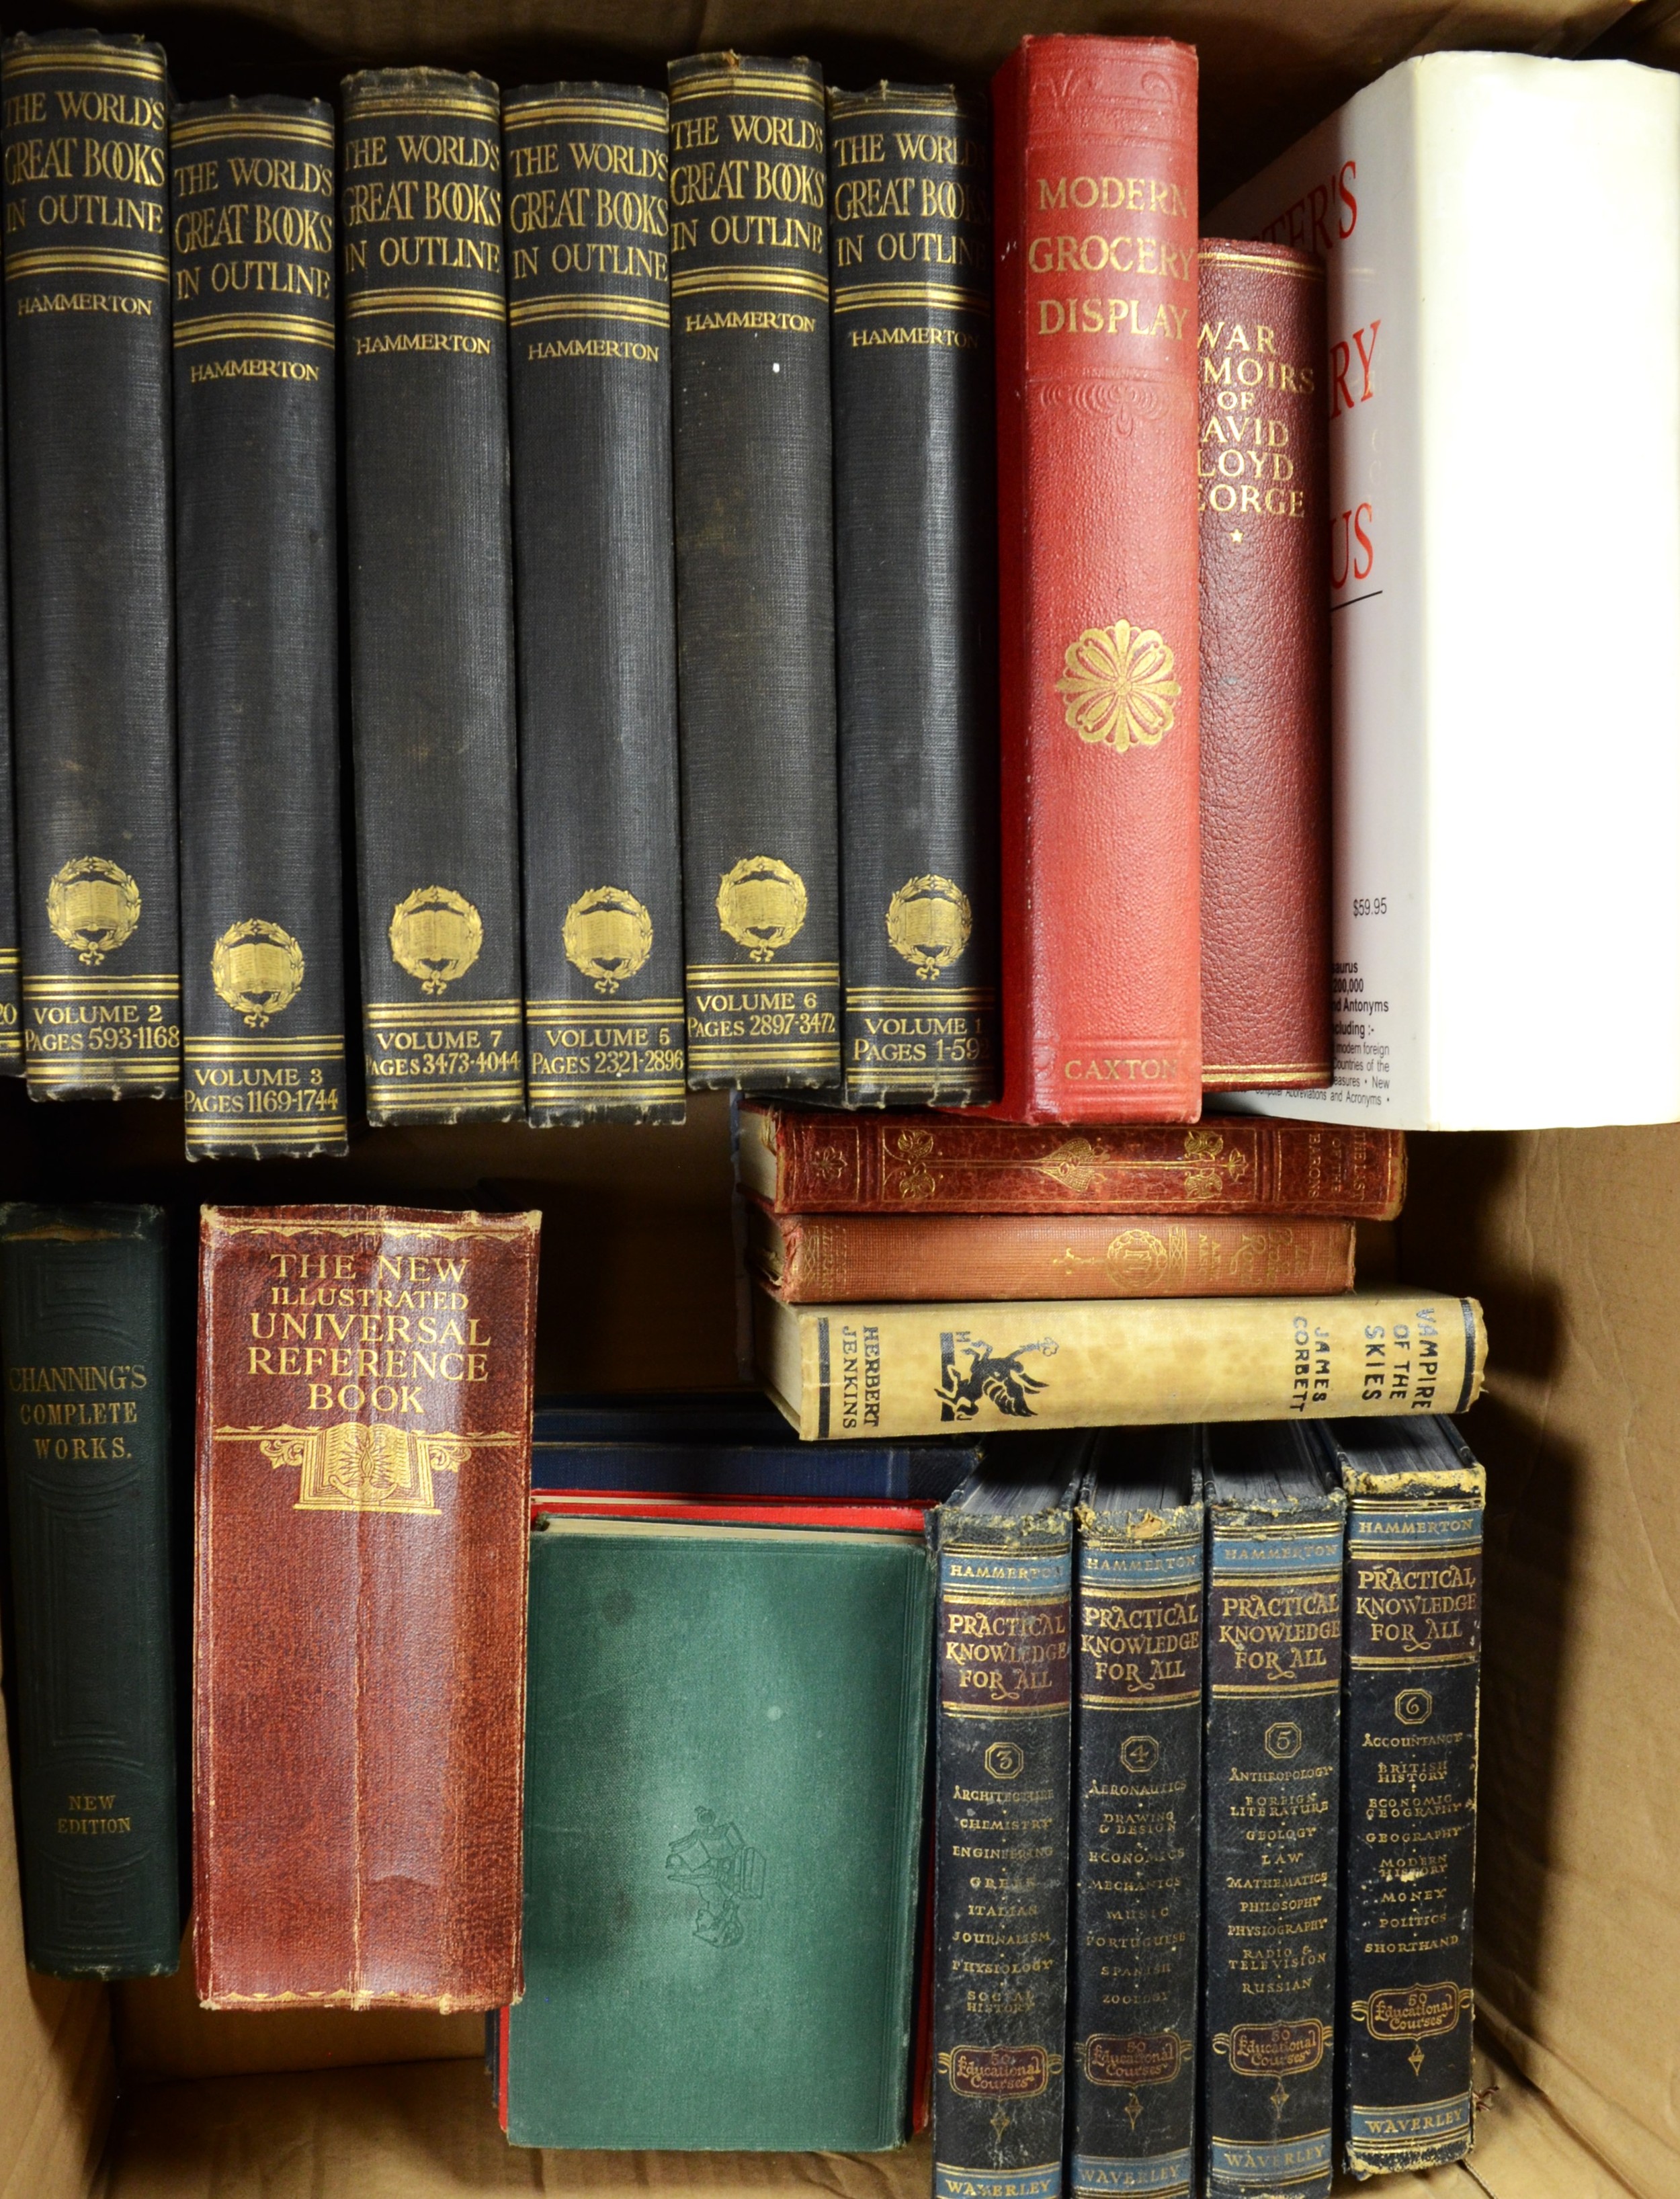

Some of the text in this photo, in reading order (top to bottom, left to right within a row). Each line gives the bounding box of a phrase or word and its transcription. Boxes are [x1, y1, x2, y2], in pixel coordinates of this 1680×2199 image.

[4, 91, 165, 130] THE WORLD'S
[671, 115, 823, 153] THE WORLD'S
[345, 136, 499, 171] THE WORLD'S
[511, 143, 668, 181] THE WORLD'S
[833, 134, 885, 167] THE
[5, 139, 165, 188] GREAT BOOKS
[175, 158, 332, 198] THE WORLD'S
[671, 161, 825, 208] GREAT BOOKS
[343, 181, 501, 226] GREAT BOOKS
[835, 178, 915, 222] GREAT
[1037, 176, 1189, 218] MODERN
[5, 195, 163, 234] IN OUTLINE
[511, 188, 668, 237] GREAT BOOKS
[175, 205, 331, 253] GREAT BOOKS
[672, 216, 823, 254] IN OUTLINE
[345, 237, 500, 274] IN OUTLINE
[513, 244, 668, 282] IN OUTLINE
[837, 235, 864, 267] IN
[1028, 235, 1195, 282] GROCERY
[177, 261, 329, 300] IN OUTLINE
[17, 294, 152, 315] HAMMERTON
[685, 311, 815, 332] HAMMERTON
[1038, 299, 1189, 341] DISPLAY
[356, 334, 491, 354] HAMMERTON
[852, 328, 978, 348] HAMMERTON
[1198, 321, 1276, 354] WAR
[529, 340, 659, 361] HAMMERTON
[191, 360, 319, 382] HAMMERTON
[1203, 357, 1315, 395] MOIRS
[1217, 390, 1255, 411] OF
[1198, 417, 1289, 448] AVID
[1198, 448, 1294, 481] LOYD
[1198, 483, 1304, 517] ORGE
[1353, 898, 1388, 918] $59.95
[696, 993, 816, 1011] VOLUME 6
[1344, 999, 1389, 1015] Antonyms
[34, 1005, 162, 1025] VOLUME 2
[688, 1013, 835, 1038] PAGES 2897-3472
[864, 1018, 967, 1036] VOLUME
[26, 1026, 179, 1052] PAGES 593-1168
[376, 1030, 502, 1050] VOLUME 7
[546, 1028, 670, 1048] VOLUME 5
[853, 1038, 927, 1062] PAGES
[1363, 1043, 1390, 1057] foreign
[366, 1052, 520, 1076] PAGES 3473-4044
[532, 1050, 684, 1075] PAGES 2321-2896
[1064, 1059, 1178, 1080] CAXTON
[1367, 1059, 1374, 1071] of
[1378, 1059, 1390, 1073] the
[194, 1068, 323, 1087] VOLUME 3
[1372, 1076, 1390, 1089] New
[185, 1088, 338, 1114] PAGES 1169-1744
[1331, 1090, 1382, 1108] and Acronyms
[270, 1254, 471, 1284] THE NEW
[271, 1287, 469, 1311] ILLUSTRATED
[250, 1313, 491, 1347] UNIVERSAL
[248, 1347, 489, 1382] REFERENCE
[1290, 1316, 1310, 1412] CORBETT
[1312, 1327, 1330, 1402] JAMES
[1361, 1325, 1386, 1401] SKIES
[1389, 1324, 1410, 1399] OF THE
[1411, 1308, 1438, 1409] VAMPIRE
[9, 1364, 147, 1393] CHANNING'S
[843, 1326, 857, 1429] JENKINS
[863, 1325, 880, 1427] HERBERT
[307, 1383, 425, 1413] BOOK
[20, 1401, 137, 1425] COMPLETE
[33, 1437, 132, 1459] WORKS.
[1359, 1519, 1474, 1534] HAMMERTON
[1087, 1554, 1198, 1572] HAMMERTON
[1224, 1544, 1338, 1561] HAMMERTON
[950, 1565, 1064, 1581] HAMMERTON
[1358, 1565, 1476, 1593] PRACTICAL
[1084, 1603, 1198, 1631] PRACTICAL
[1222, 1593, 1339, 1620] PRACTICAL
[1355, 1593, 1477, 1620] KNOWLEDGE
[948, 1613, 1066, 1637] PRACTICAL
[1219, 1620, 1341, 1647] KNOWLEDGE
[1371, 1619, 1462, 1652] FOR ALL
[1081, 1631, 1199, 1658] KNOWLEDGE
[1096, 1659, 1185, 1692] FOR ALL
[1234, 1647, 1327, 1680] FOR ALL
[960, 1669, 1052, 1700] FOR ALL
[1406, 1696, 1419, 1714] 6
[1277, 1731, 1290, 1749] 5
[1362, 1733, 1463, 1747] ACCOUNTANCY
[996, 1750, 1013, 1770] 3
[1129, 1743, 1150, 1763] 4
[1229, 1767, 1333, 1782] ANTHROPOLOGY
[1378, 1761, 1447, 1774] BRITISH
[1378, 1771, 1447, 1783] HISTORY
[68, 1795, 116, 1811] NEW
[1230, 1801, 1329, 1817] LITERATURE
[1366, 1802, 1462, 1819] GEOGRAPHY
[1369, 1794, 1452, 1808] ECONOMIC
[57, 1817, 130, 1834] EDITION
[1246, 1827, 1316, 1841] GEOLOGY
[1366, 1826, 1462, 1842] GEOGRAPHY
[1261, 1853, 1304, 1865] LAW
[1380, 1854, 1447, 1868] MODERN
[1226, 1872, 1328, 1889] MATHEMATICS
[1240, 1896, 1322, 1912] PHILOSOPHY
[1381, 1889, 1447, 1902] MONEY
[1228, 1918, 1328, 1936] PHYSIOGRAPHY
[1379, 1914, 1447, 1928] POLITICS
[1243, 1948, 1292, 1959] RADIO
[1365, 1935, 1459, 1952] SHORTHAND
[1228, 1952, 1327, 1970] TELEVISION
[1243, 1977, 1312, 1994] RUSSIAN
[1374, 1995, 1453, 2021] Educational
[1390, 2014, 1447, 2030] Courses
[1365, 2108, 1463, 2134] WAVERLEY
